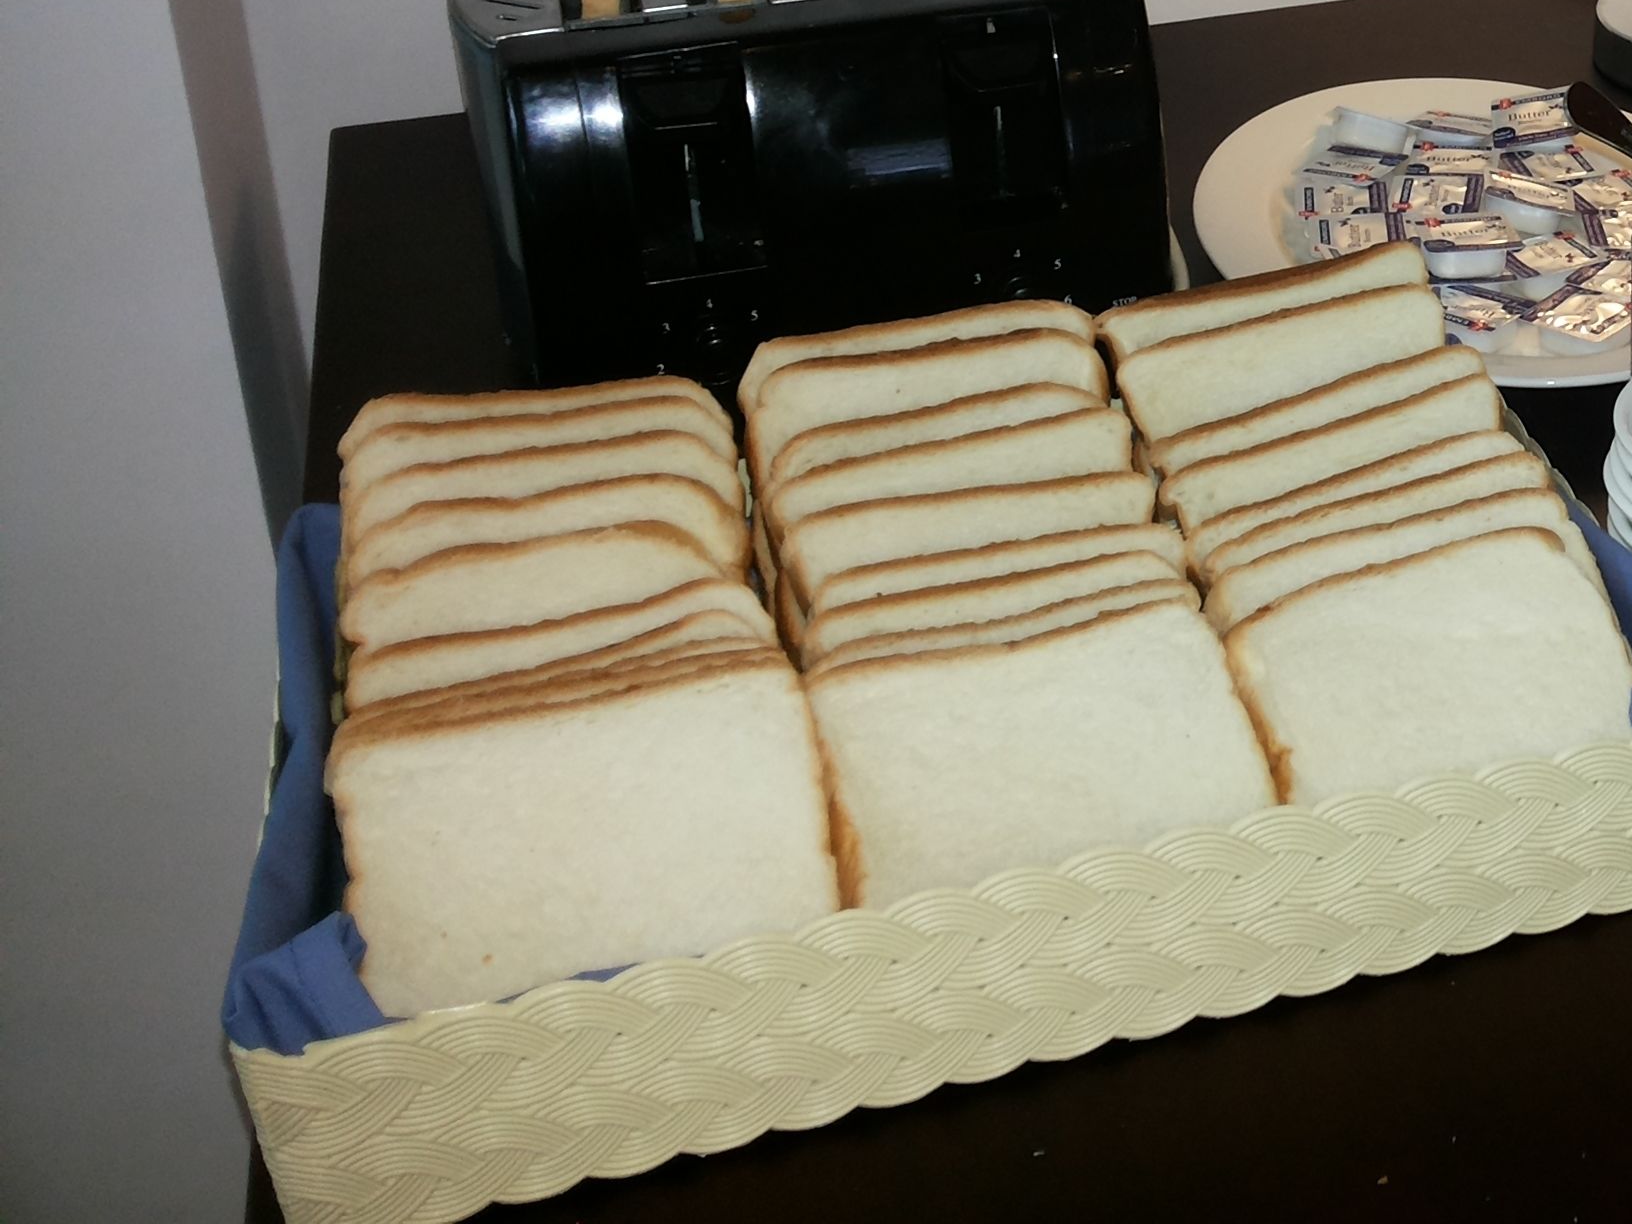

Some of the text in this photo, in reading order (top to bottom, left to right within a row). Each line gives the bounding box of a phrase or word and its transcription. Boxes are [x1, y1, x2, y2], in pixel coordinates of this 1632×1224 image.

[1508, 111, 1550, 121] Butter
[1054, 259, 1062, 270] 5
[973, 274, 981, 284] 3
[1112, 296, 1137, 307] STOP
[751, 310, 758, 321] 5
[656, 363, 665, 376] 2
